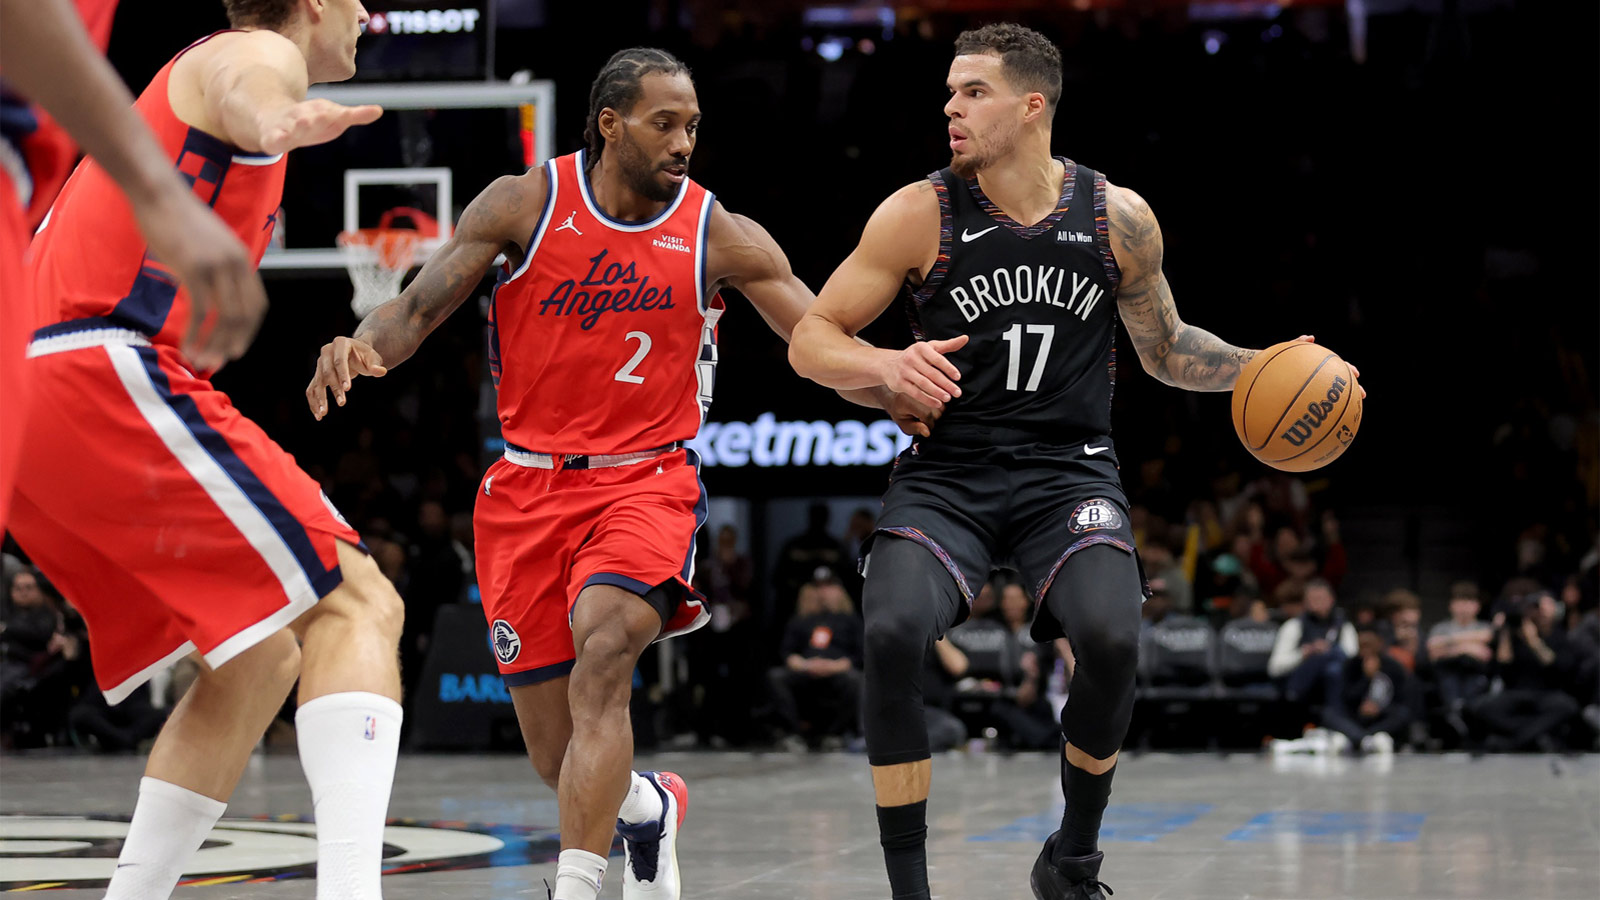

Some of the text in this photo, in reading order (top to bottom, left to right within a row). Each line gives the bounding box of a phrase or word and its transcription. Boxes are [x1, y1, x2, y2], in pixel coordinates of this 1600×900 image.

[386, 8, 480, 34] TISSOT
[652, 238, 691, 253] RWANDA
[661, 234, 684, 245] VISIT
[1057, 230, 1093, 243] All In Won
[580, 248, 639, 287] Los
[539, 276, 676, 331] Angeles
[950, 265, 1104, 323] BROOKLYN
[614, 331, 652, 385] 2
[1002, 323, 1055, 392] 17
[1281, 374, 1347, 447] Wilson
[1088, 507, 1101, 522] B
